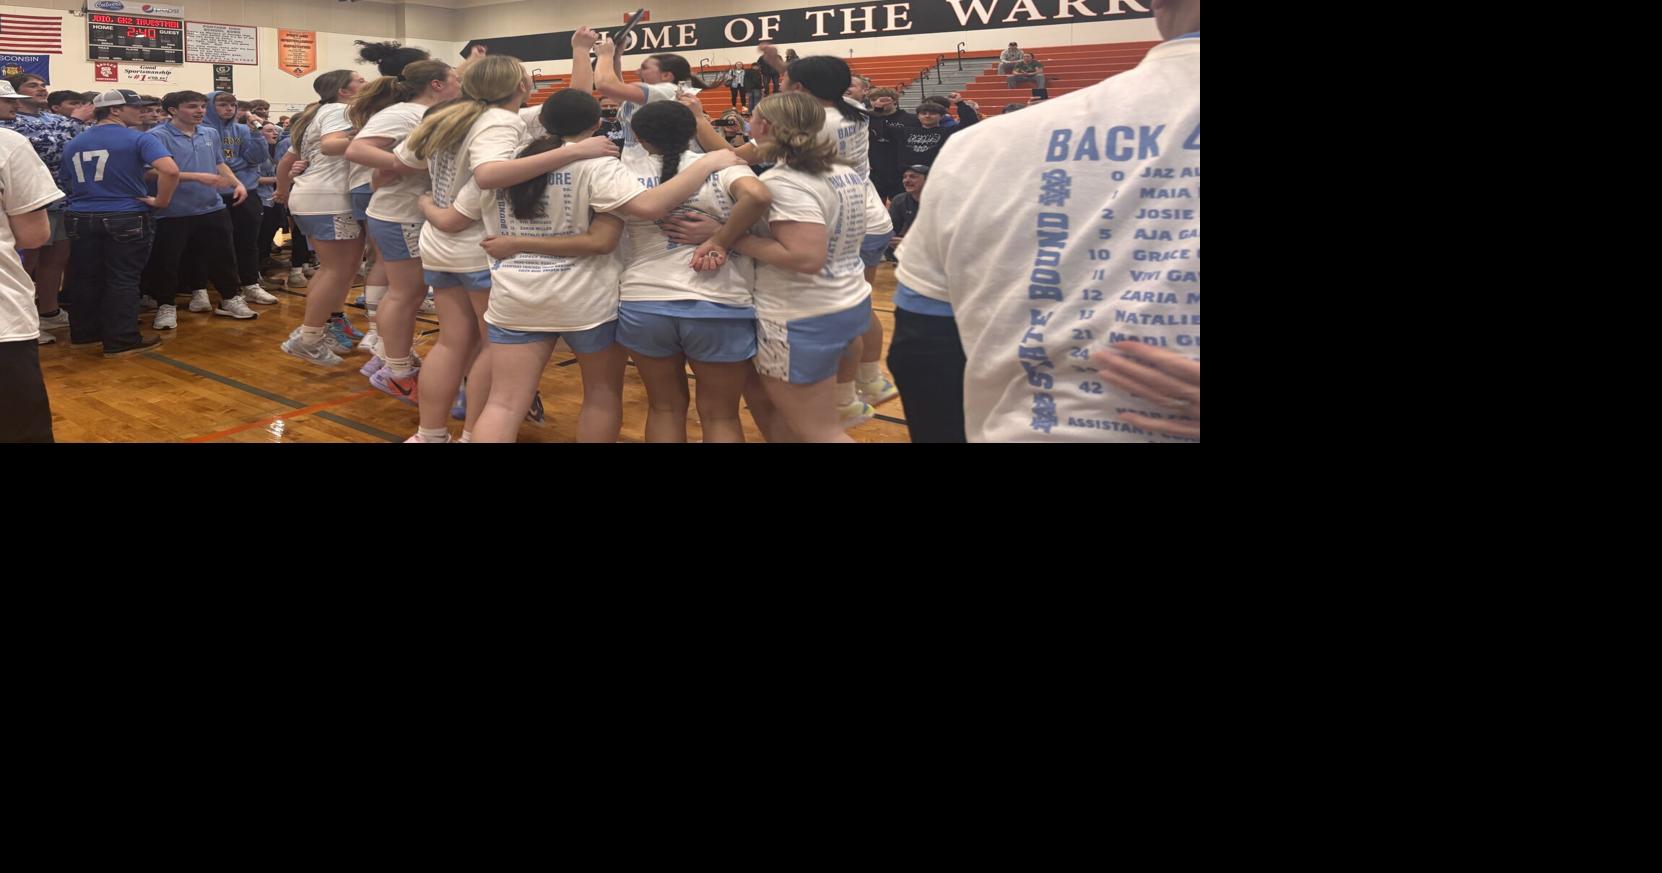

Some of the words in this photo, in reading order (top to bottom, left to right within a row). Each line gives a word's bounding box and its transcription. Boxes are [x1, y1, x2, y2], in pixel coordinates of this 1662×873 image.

[724, 15, 781, 43] OF
[804, 1, 914, 37] THE
[127, 27, 156, 38] 2:40
[125, 68, 172, 76] Sportsmanship
[1046, 125, 1165, 162] BACK
[72, 150, 109, 182] 17
[1111, 171, 1124, 181] 0
[1141, 167, 1174, 178] JAZ
[1140, 188, 1192, 199] MAIA
[1102, 209, 1114, 219] 2
[1135, 209, 1194, 220] JOSIE
[1099, 229, 1111, 239] 5
[1134, 229, 1173, 241] AJA
[1178, 229, 1199, 239] GA
[1027, 212, 1069, 302] BOUND
[1088, 249, 1110, 260] 10
[1133, 250, 1191, 261] GRACE
[1167, 270, 1199, 282] GA
[1083, 289, 1103, 300] 12
[1120, 290, 1177, 304] ZARIA
[1115, 309, 1199, 325] NATALIE
[1072, 328, 1092, 340] 21
[1079, 381, 1103, 394] 42
